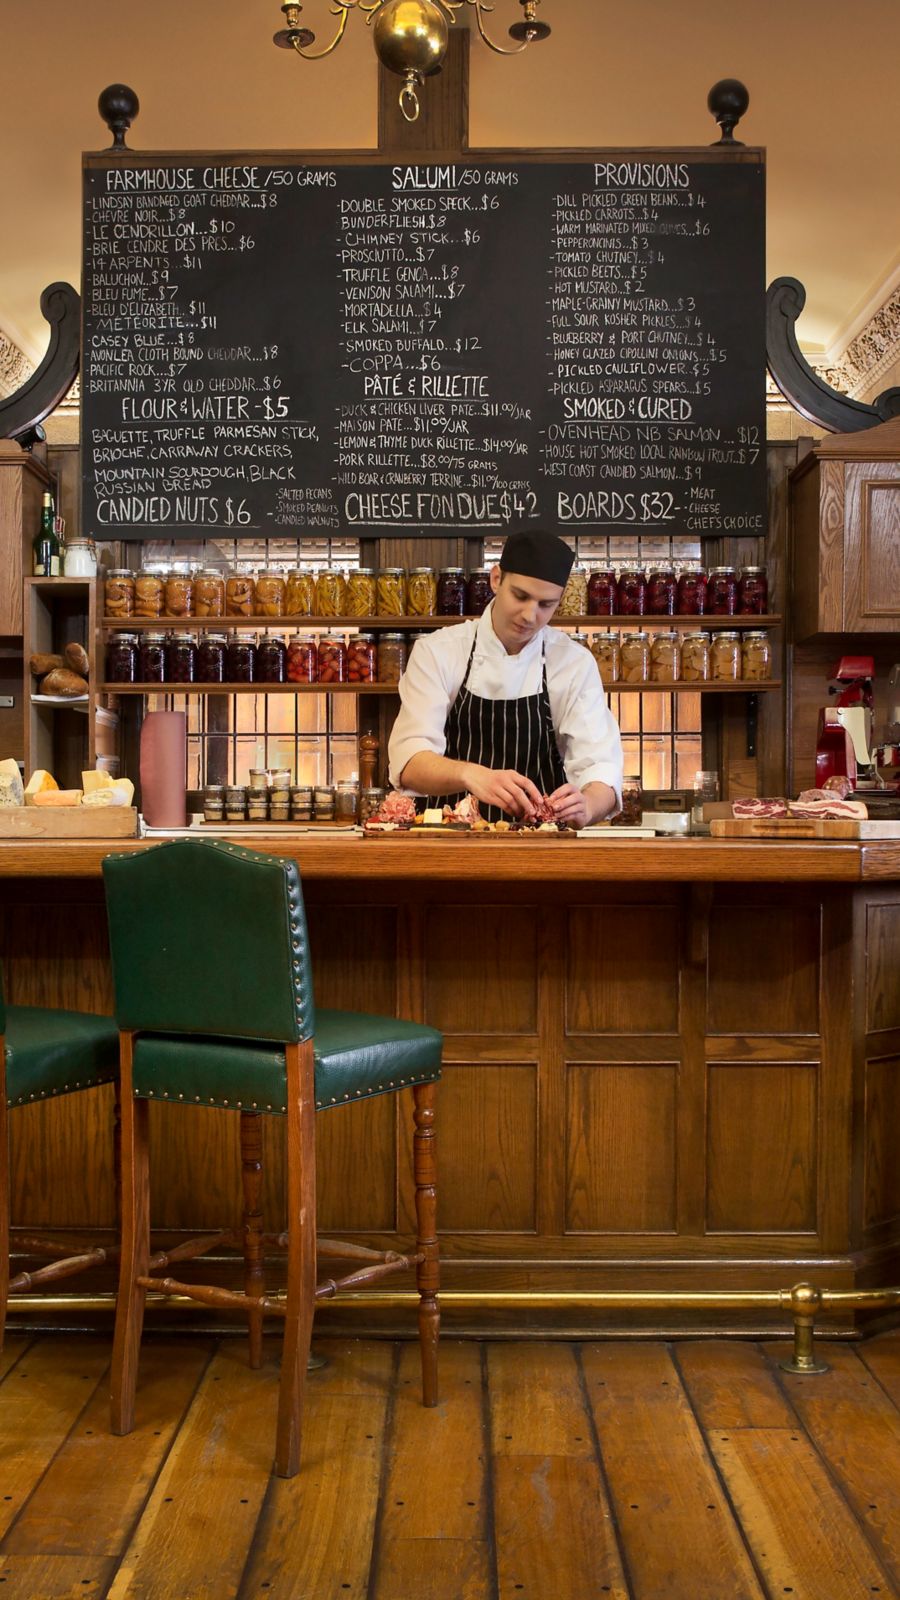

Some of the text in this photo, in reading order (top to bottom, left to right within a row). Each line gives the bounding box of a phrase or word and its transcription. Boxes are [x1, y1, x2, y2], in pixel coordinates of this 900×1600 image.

[106, 169, 195, 191] FARMHOUSE
[203, 167, 260, 189] CHEESE
[297, 172, 336, 187] GRAMS
[392, 166, 456, 190] SALUMI
[485, 171, 519, 186] GRAMS
[595, 163, 690, 188] PROVISIONS
[136, 195, 180, 208] BANDAGED
[184, 194, 206, 207] GOAT
[390, 197, 436, 212] SMOKED
[582, 194, 617, 206] PICKLED
[621, 193, 647, 206] GREEN
[585, 223, 629, 234] MARINATED
[632, 223, 655, 234] MIXED
[127, 240, 168, 253] CENDRE
[175, 238, 195, 251] DES
[345, 233, 403, 246] CHIMNEY
[575, 314, 599, 326] SOUR
[605, 314, 637, 326] KOSHER
[622, 330, 645, 343] PORT
[138, 349, 169, 361] CLOTH
[174, 348, 203, 360] BOUND
[583, 348, 615, 359] GLAZED
[620, 348, 658, 359] CIPOLLINI
[558, 363, 693, 378] PICKLED CAULIFLOWER..
[154, 378, 176, 393] 3YR
[183, 379, 204, 393] OLD
[364, 373, 403, 395] PÂTÉ
[422, 375, 489, 397] RILLETTE
[600, 378, 647, 393] ASPARAGUS
[122, 398, 178, 420] FLOUR
[192, 396, 249, 420] WATER
[379, 403, 416, 416] CHICKEN
[420, 403, 445, 414] LIVER
[564, 398, 625, 420] SMOKED
[638, 397, 692, 421] CURED
[92, 426, 319, 444] BAGUETTE, TRUFFLE PARMESAN STICK,
[549, 425, 630, 442] OVENHEAD
[637, 426, 661, 441] NB
[668, 426, 720, 442] SALMON
[378, 435, 408, 448] THYME
[411, 437, 433, 449] DUCK
[93, 444, 293, 463] BRIOCHE, CARRAWAY CRACKERS,
[580, 445, 598, 459] HOT
[601, 445, 636, 460] SMOKED
[640, 445, 666, 459] LOCAL
[669, 446, 705, 462] RAINBOW
[468, 460, 497, 471] GRAMS
[569, 464, 596, 478] COAST
[600, 465, 636, 478] CANDIED
[95, 465, 296, 482] MOUNTAIN SOURDOUGH, BLACK
[94, 479, 211, 499] RUSSIAN BREAD
[359, 473, 379, 485] BOAR
[385, 473, 426, 486] CRANBERRY
[509, 480, 531, 491] GRAMS
[278, 488, 332, 500] SALTED PECANS
[690, 488, 715, 499] MEAT
[97, 498, 170, 524] CANDIED
[176, 497, 219, 523] NUTS
[278, 502, 339, 515] SMOKED PEANUTS
[345, 492, 412, 520] CHEESE
[417, 492, 500, 519] FONDUE
[557, 491, 636, 520] BOARDS
[689, 502, 720, 514] CHEESE
[277, 514, 339, 527] CANDIED WALNUTS
